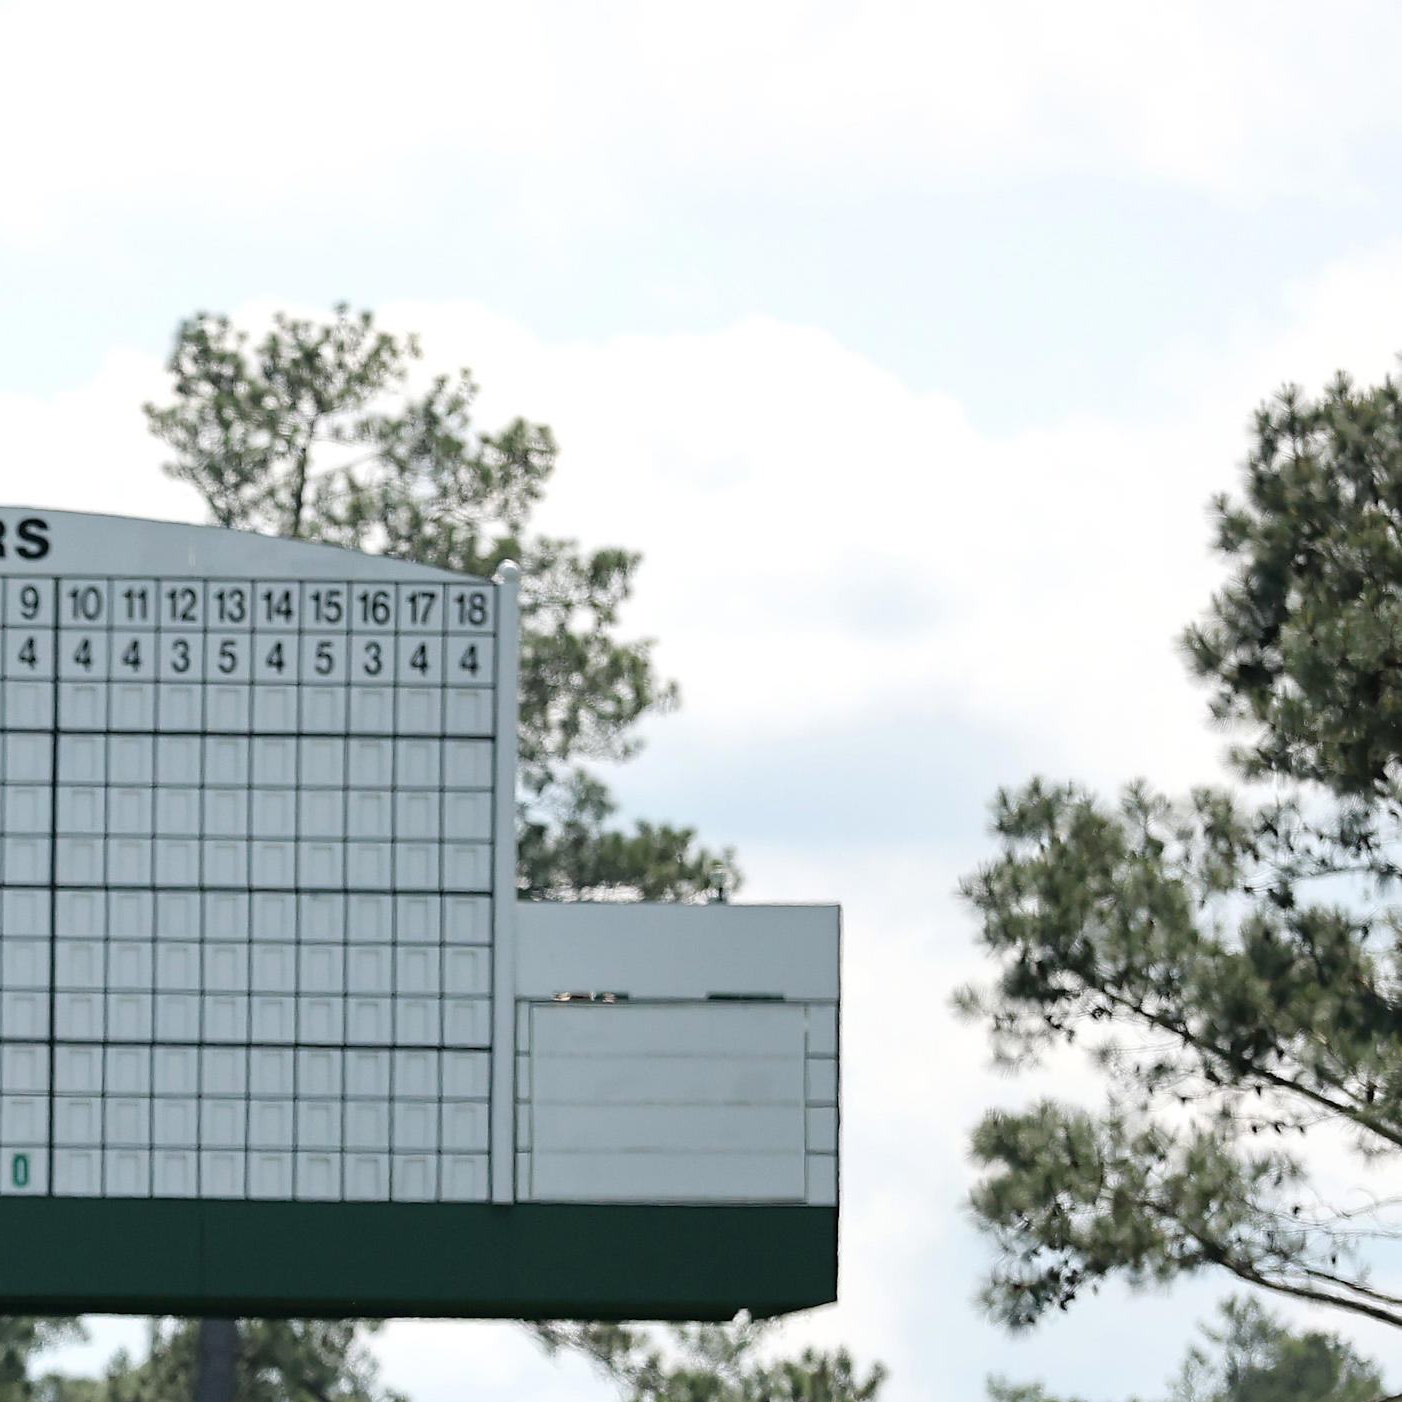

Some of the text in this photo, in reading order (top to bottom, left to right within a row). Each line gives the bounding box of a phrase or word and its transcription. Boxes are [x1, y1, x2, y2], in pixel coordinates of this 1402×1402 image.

[19, 584, 41, 621] 9
[67, 585, 104, 621] 10
[121, 588, 149, 620] 11
[166, 587, 198, 622] 12
[214, 588, 247, 624] 13
[262, 590, 294, 622] 14
[309, 589, 344, 625] 15
[358, 590, 392, 626] 16
[406, 591, 438, 625] 17
[453, 591, 489, 627] 18
[17, 636, 39, 669] 4
[72, 638, 94, 670] 4
[121, 639, 143, 672] 4
[170, 638, 192, 674] 3
[217, 639, 239, 675] 5
[264, 641, 286, 673] 4
[314, 640, 336, 676] 5
[362, 641, 384, 677] 3
[408, 642, 430, 675] 4
[458, 643, 481, 676] 4
[10, 1153, 31, 1188] 0
